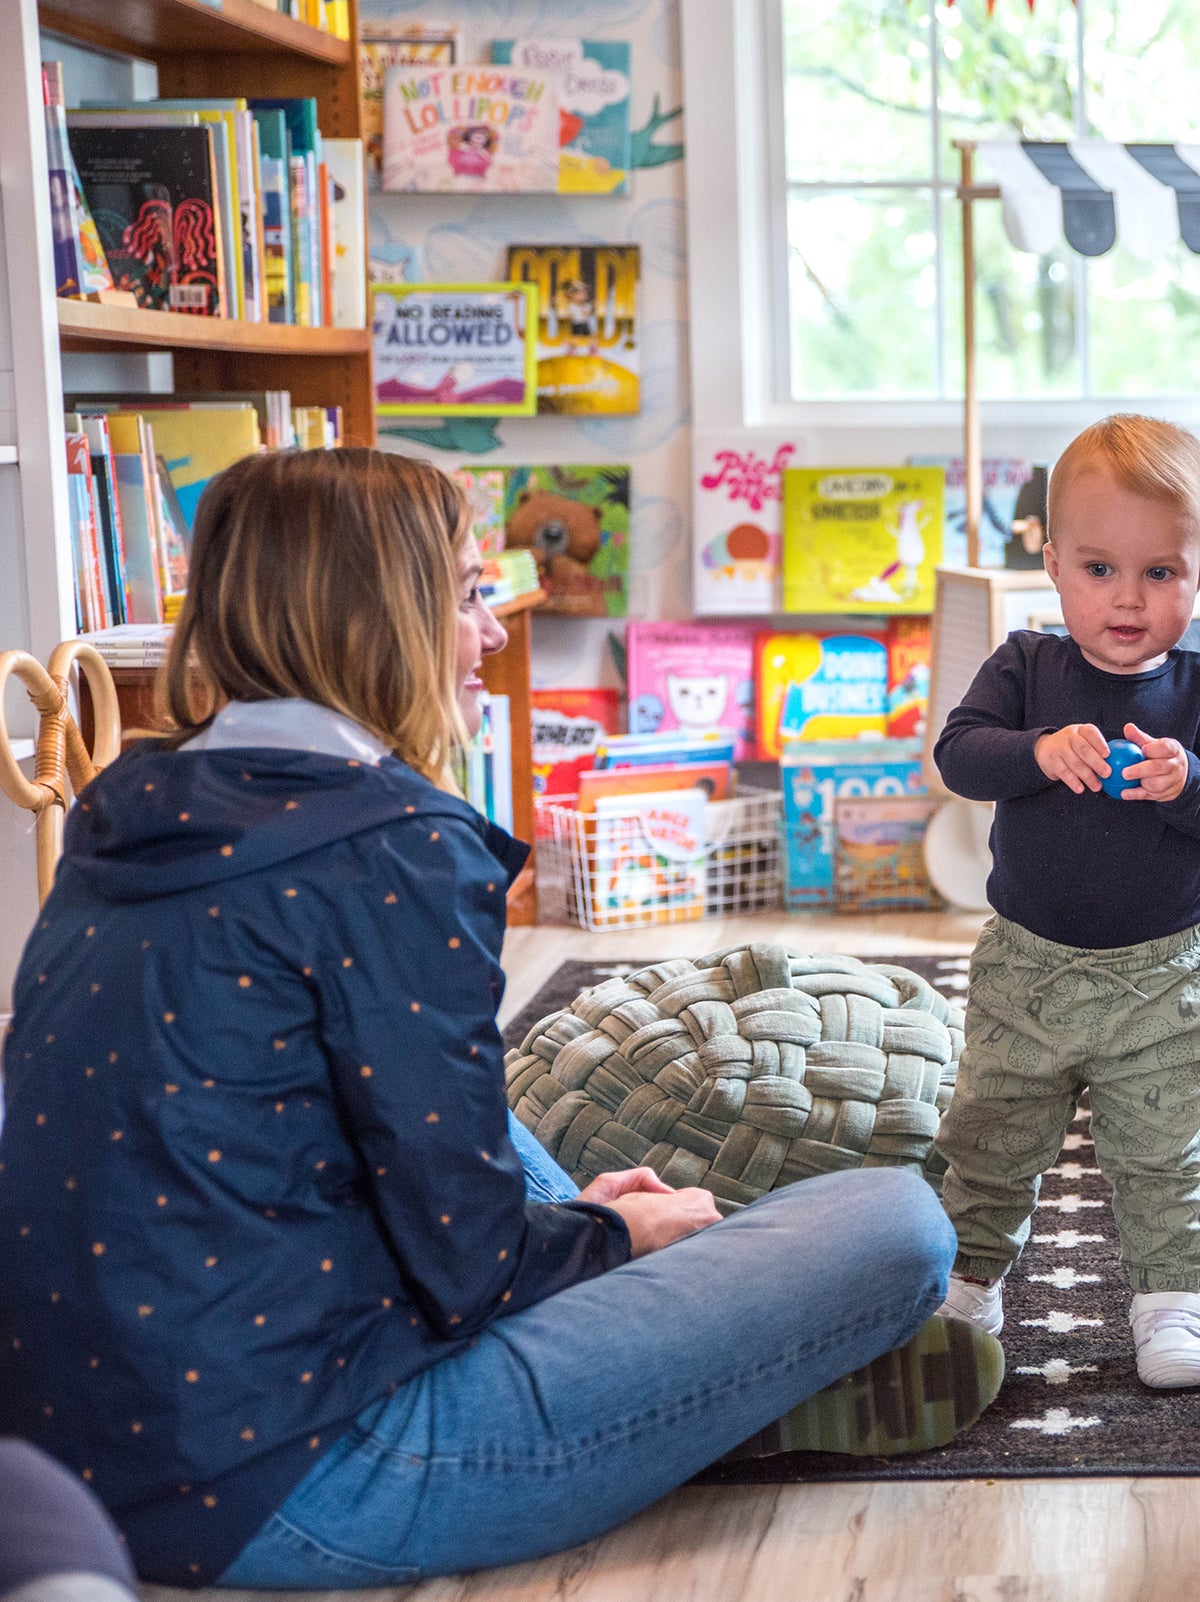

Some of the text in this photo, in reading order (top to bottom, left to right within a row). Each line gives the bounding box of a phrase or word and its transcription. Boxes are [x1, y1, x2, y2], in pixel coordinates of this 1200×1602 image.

[400, 71, 446, 103] NOT
[452, 70, 545, 104] ENOUGH
[404, 96, 540, 135] LOLLIPOPS
[395, 303, 504, 320] NO READING
[386, 321, 512, 347] ALLOWED
[700, 443, 796, 491] Pick
